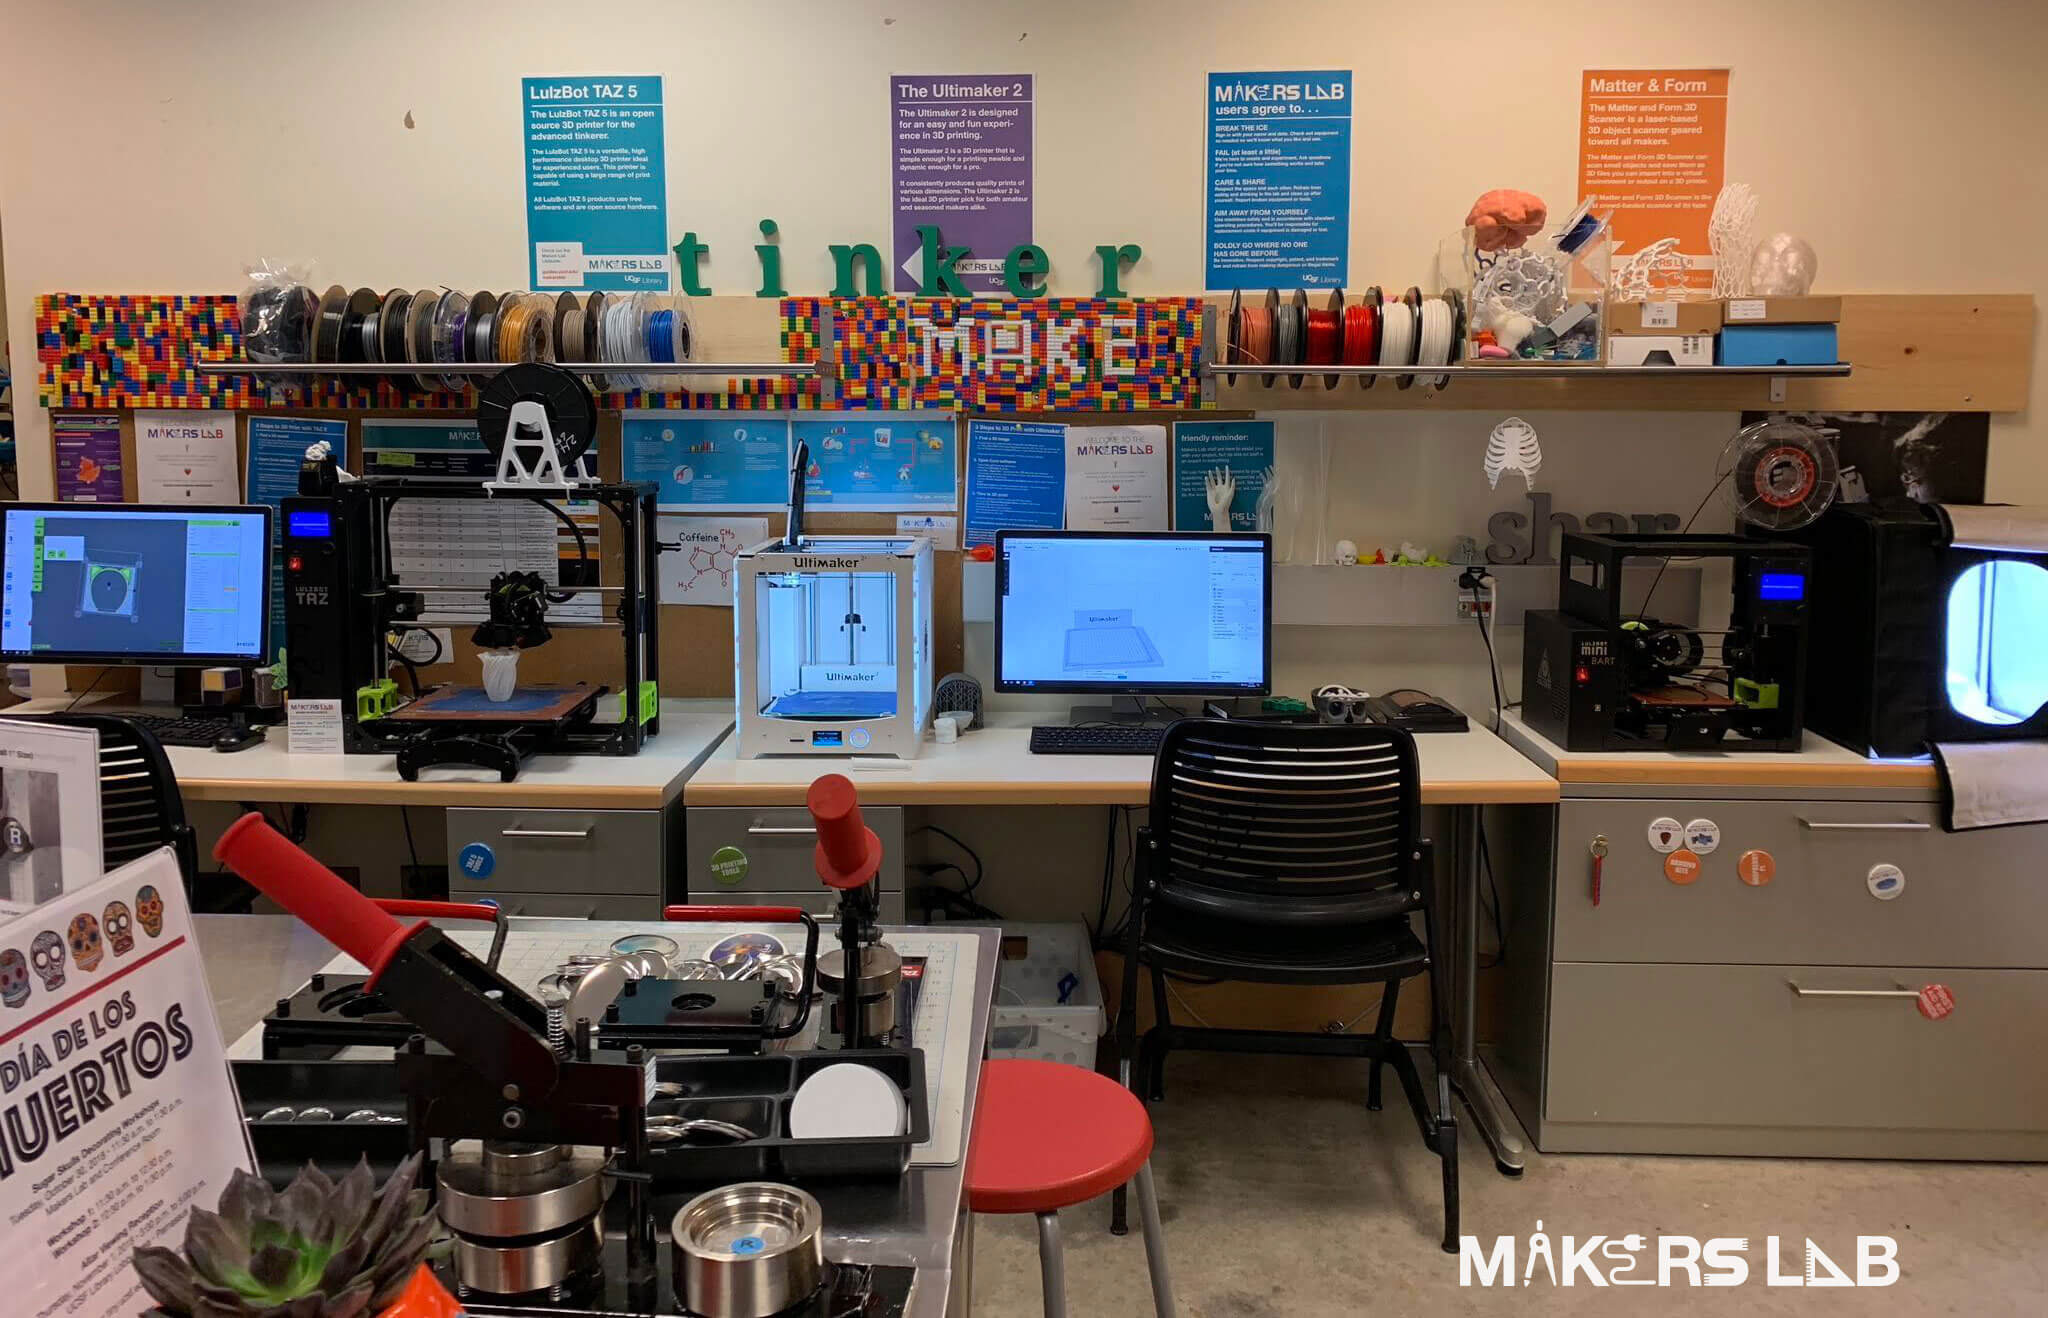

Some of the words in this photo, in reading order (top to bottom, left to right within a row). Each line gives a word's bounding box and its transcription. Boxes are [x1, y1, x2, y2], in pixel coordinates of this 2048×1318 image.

[899, 84, 928, 98] The
[933, 83, 1009, 98] Ultimaker
[1013, 83, 1023, 97] 2
[1590, 79, 1644, 93] Matter
[1648, 79, 1659, 92] &
[1664, 78, 1707, 92] Form
[530, 85, 588, 99] LulzBot
[593, 85, 624, 98] TAZ
[628, 85, 638, 98] 5
[1215, 81, 1300, 102] MAKERS
[1305, 83, 1345, 100] LAB
[1216, 106, 1248, 115] users
[1252, 104, 1286, 116] agree
[1589, 104, 1606, 112] The
[1608, 104, 1637, 112] Matter
[1640, 103, 1657, 112] and
[1659, 104, 1682, 112] Form
[1684, 103, 1696, 112] 3D
[531, 110, 546, 118] The
[549, 109, 581, 118] LulzBot
[583, 109, 600, 118] TAZ
[602, 109, 608, 118] 5
[633, 110, 654, 119] open
[899, 109, 915, 117] The
[918, 109, 959, 117] Ultimaker
[961, 109, 967, 117] 2
[978, 108, 1018, 118] designed
[1588, 115, 1625, 123] Scanner
[1628, 115, 1635, 123] is
[1645, 115, 1698, 123] laser-based
[531, 122, 560, 130] source
[562, 121, 574, 129] 3D
[576, 121, 604, 130] printer
[927, 121, 946, 130] easy
[949, 120, 965, 128] and
[968, 120, 981, 128] fun
[983, 120, 1014, 128] experi-
[933, 131, 945, 139] 3D
[947, 131, 983, 140] printing.
[1588, 126, 1600, 134] 3D
[1603, 126, 1631, 135] object
[1671, 126, 1702, 135] geared
[531, 132, 572, 141] advanced
[575, 132, 609, 140] tinkerer.
[1588, 137, 1618, 146] toward
[1621, 137, 1632, 145] all
[1634, 137, 1670, 146] makers.
[673, 219, 1143, 298] tinker
[589, 259, 637, 270] MAKERS
[640, 259, 662, 270] LAB
[148, 428, 199, 439] MAKERS
[201, 429, 223, 439] LAB
[1182, 434, 1210, 443] friendly
[1212, 434, 1249, 442] reminder:
[1077, 445, 1127, 456] MAKERS
[1130, 445, 1153, 455] LAB
[679, 532, 720, 542] Caffeine
[792, 557, 860, 568] Ultimaker
[296, 592, 328, 605] TAZ
[1591, 657, 1616, 665] BART
[826, 672, 876, 682] Ultimaker
[1, 1042, 52, 1094] DÍA
[51, 1018, 88, 1061] DE
[89, 990, 137, 1039] LOS
